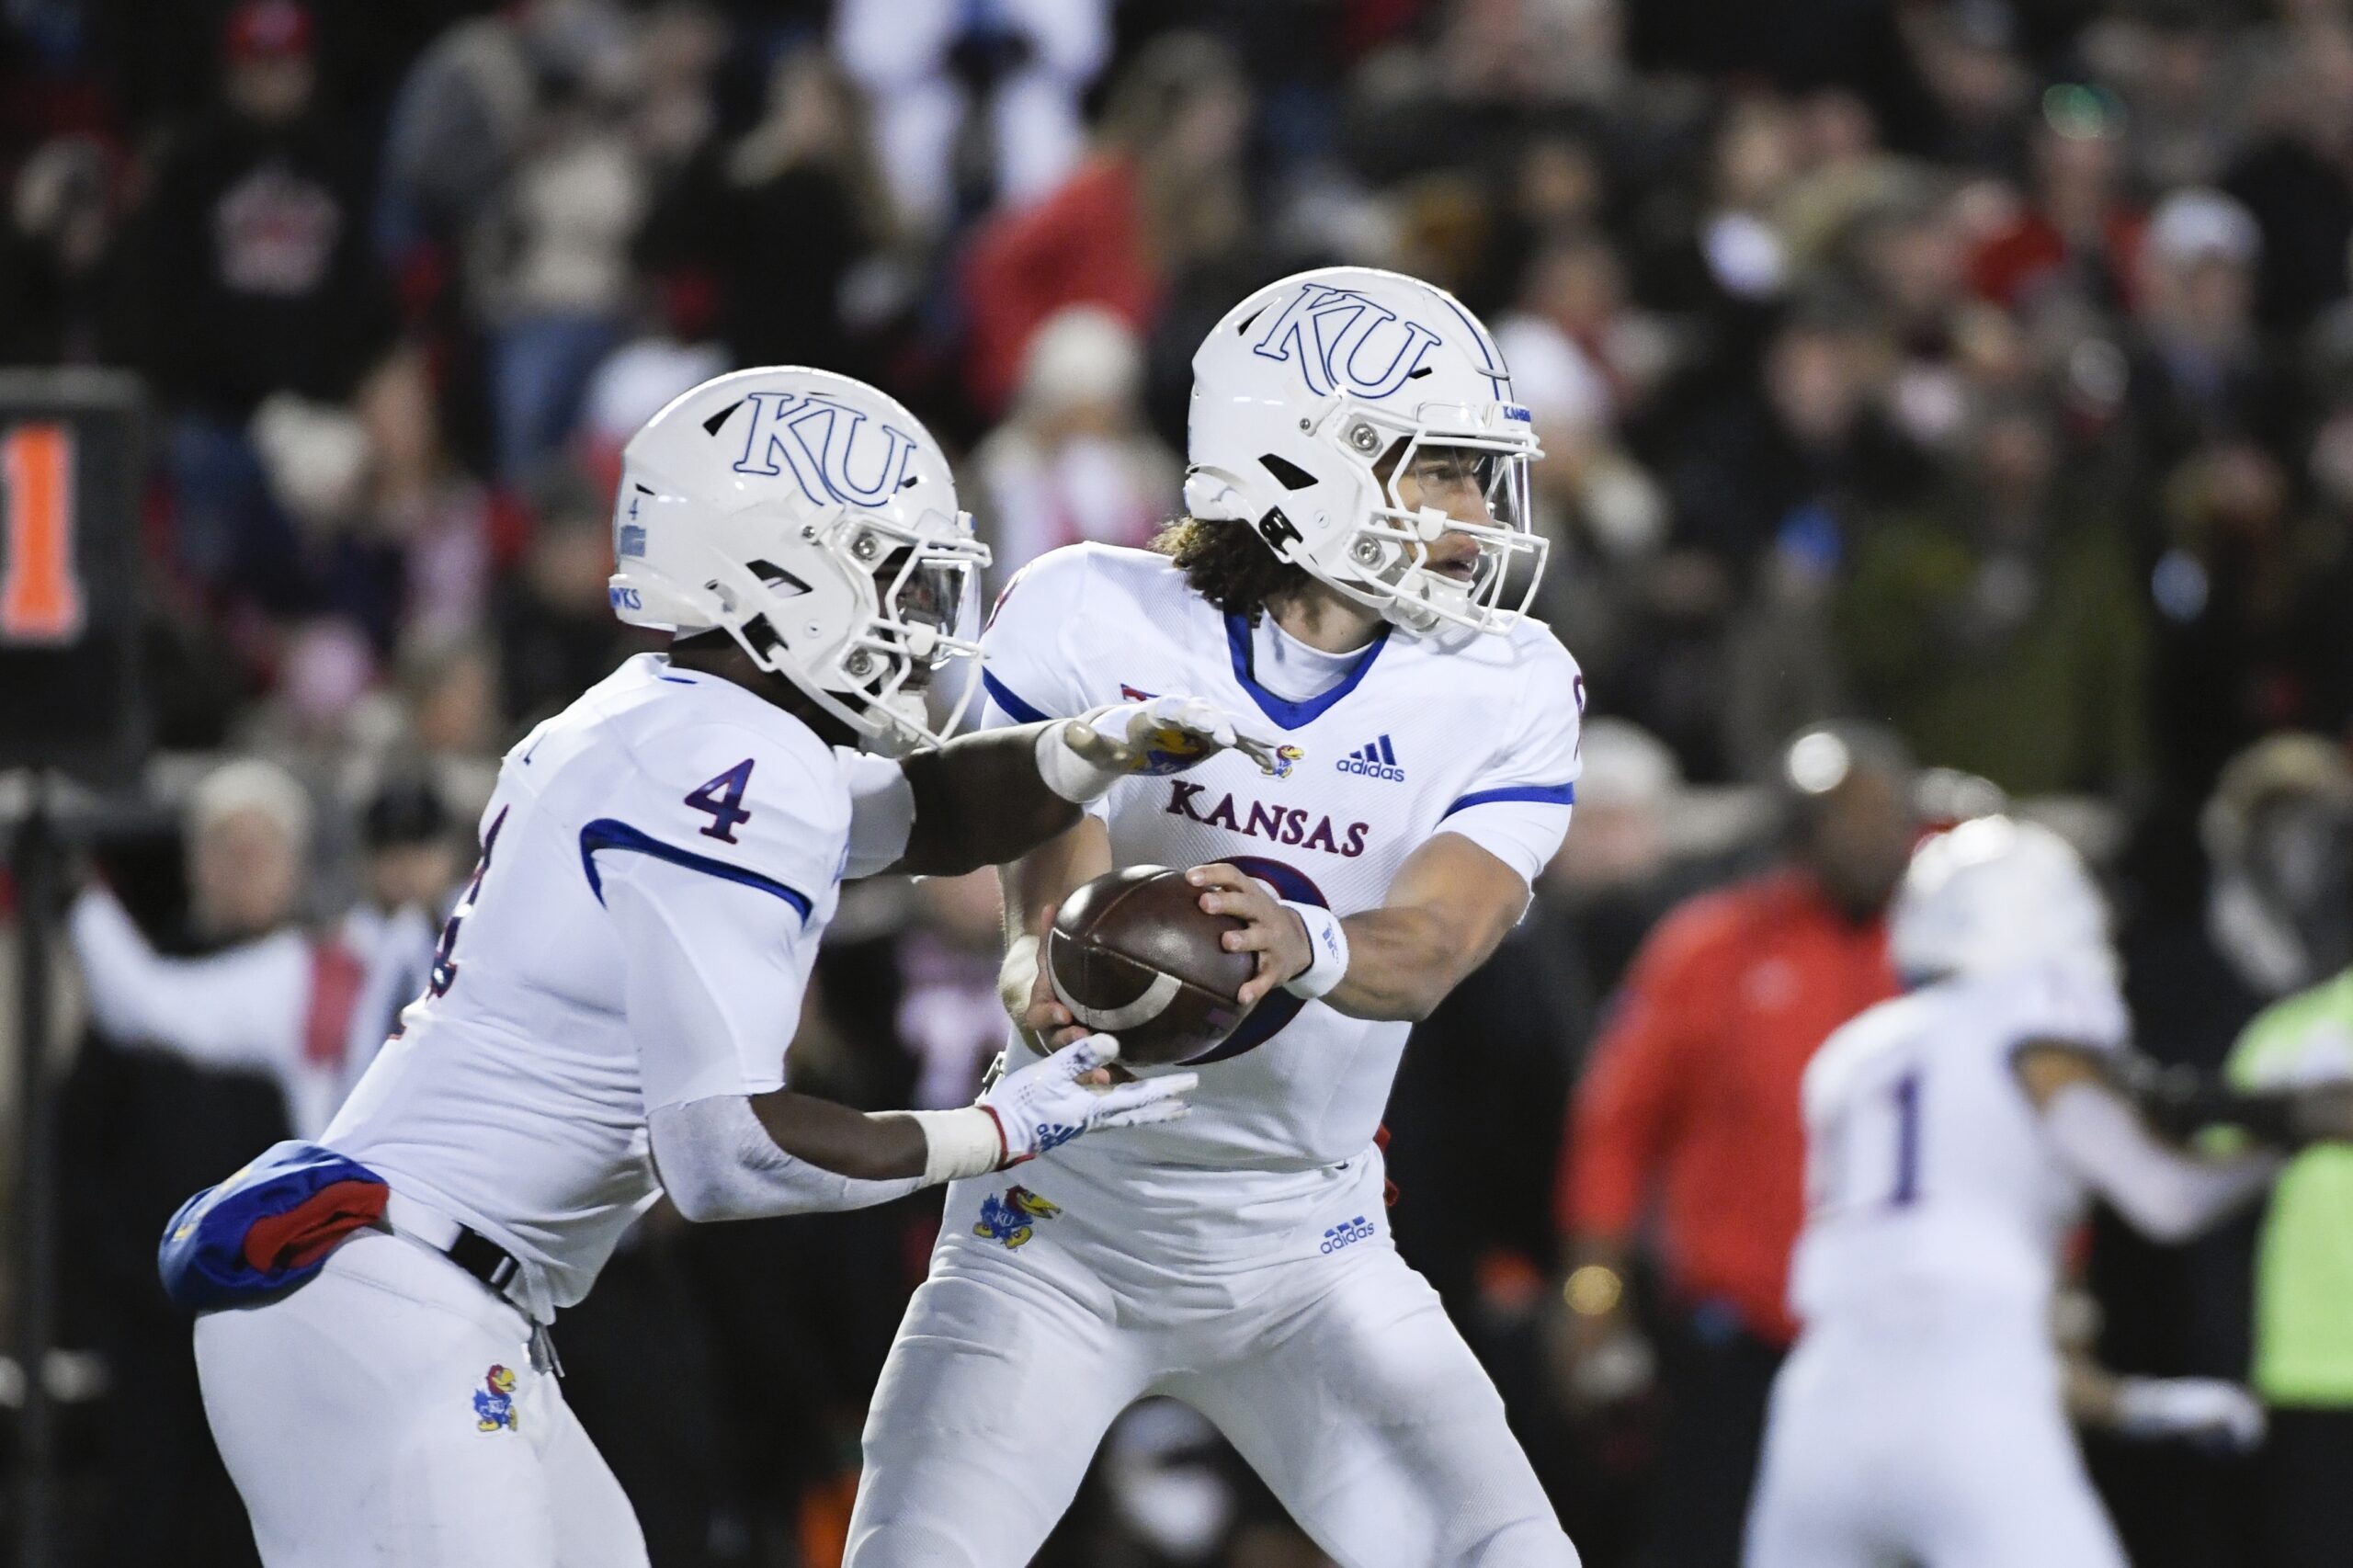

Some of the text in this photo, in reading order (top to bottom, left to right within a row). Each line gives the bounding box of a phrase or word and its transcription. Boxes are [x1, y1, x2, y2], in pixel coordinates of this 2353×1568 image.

[1253, 283, 1442, 399] KU
[733, 392, 917, 507] KU
[1503, 405, 1531, 423] KAN
[0, 422, 85, 641] 1
[684, 758, 756, 845] 4
[1336, 758, 1405, 782] adidas
[1165, 779, 1370, 858] KANSAS
[994, 1211, 1016, 1228] KU
[1320, 1222, 1375, 1254] adidas
